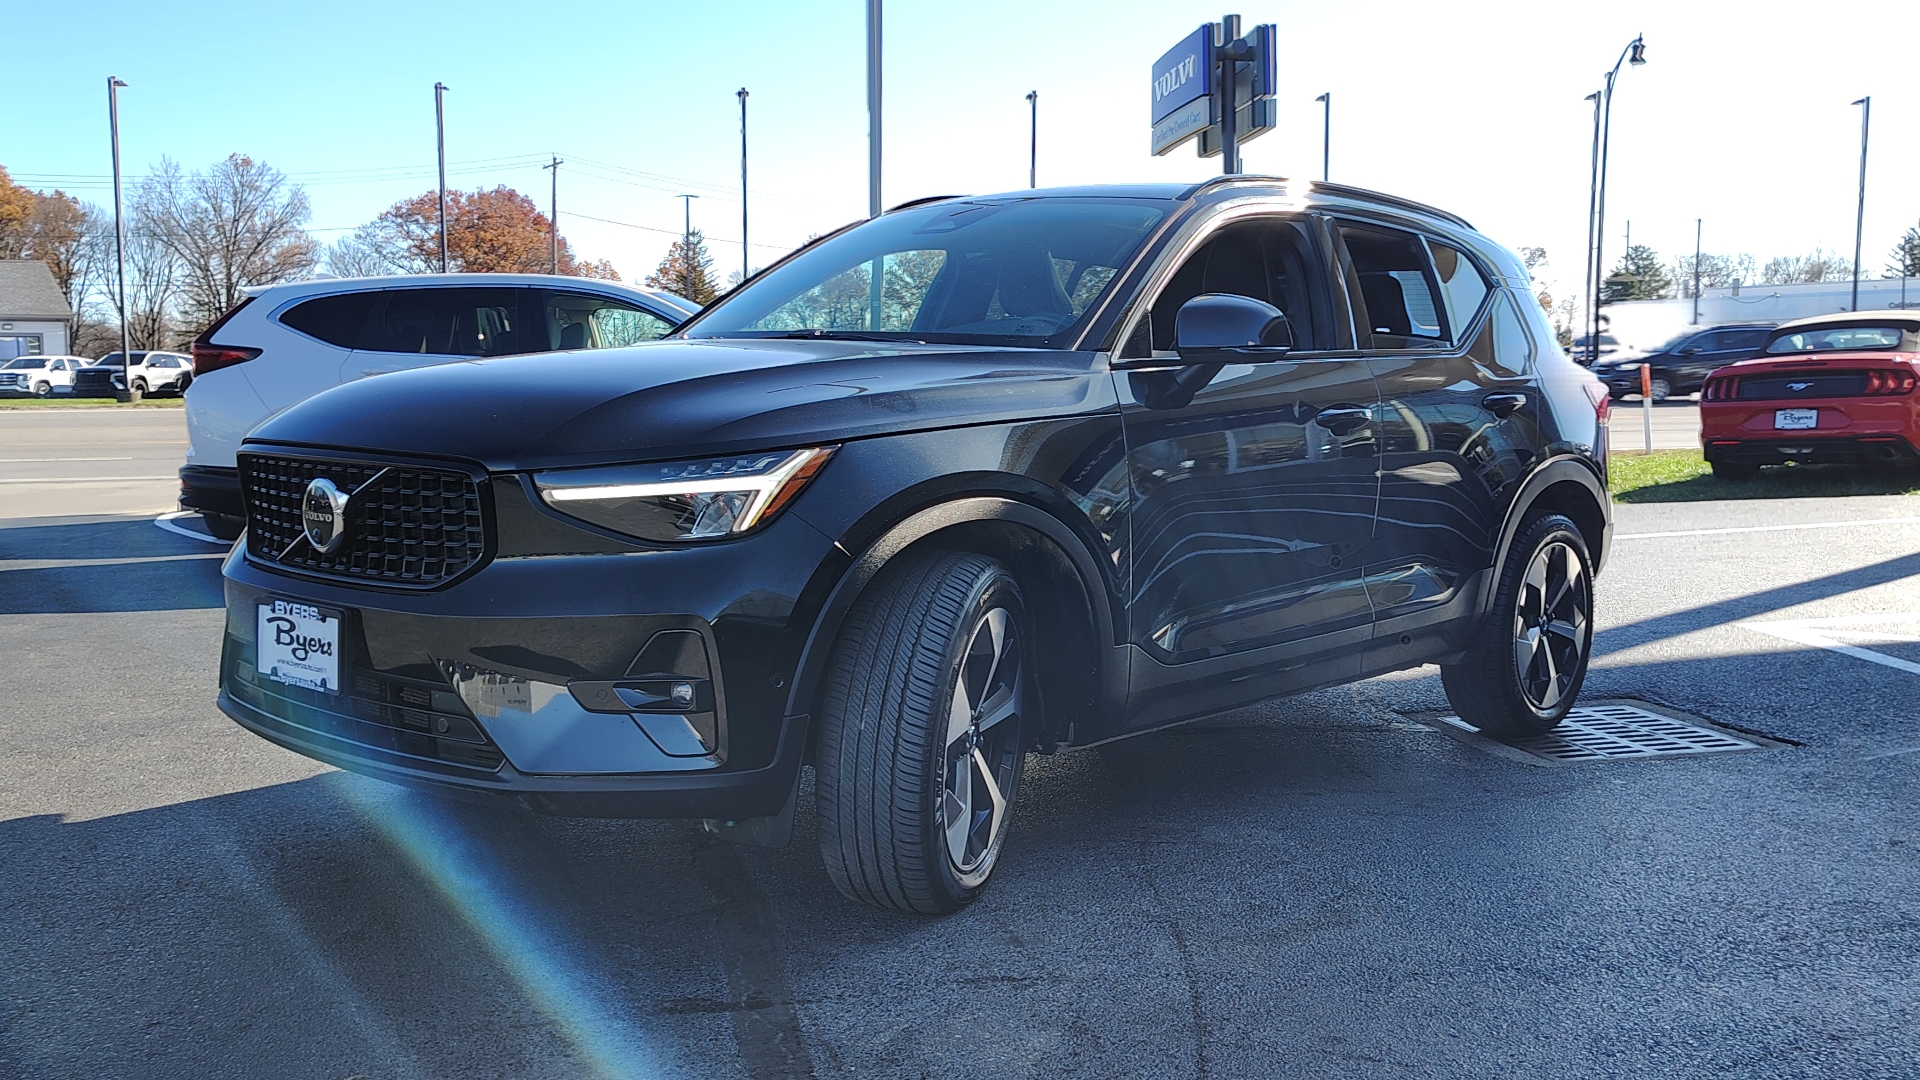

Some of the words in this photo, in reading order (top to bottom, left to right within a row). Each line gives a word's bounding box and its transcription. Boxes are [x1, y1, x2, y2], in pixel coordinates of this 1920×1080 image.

[1889, 302, 1920, 310] Collsion
[1780, 413, 1812, 423] Byers
[305, 511, 332, 522] VOLVO
[275, 600, 319, 621] BYERS
[266, 616, 332, 662] Byers
